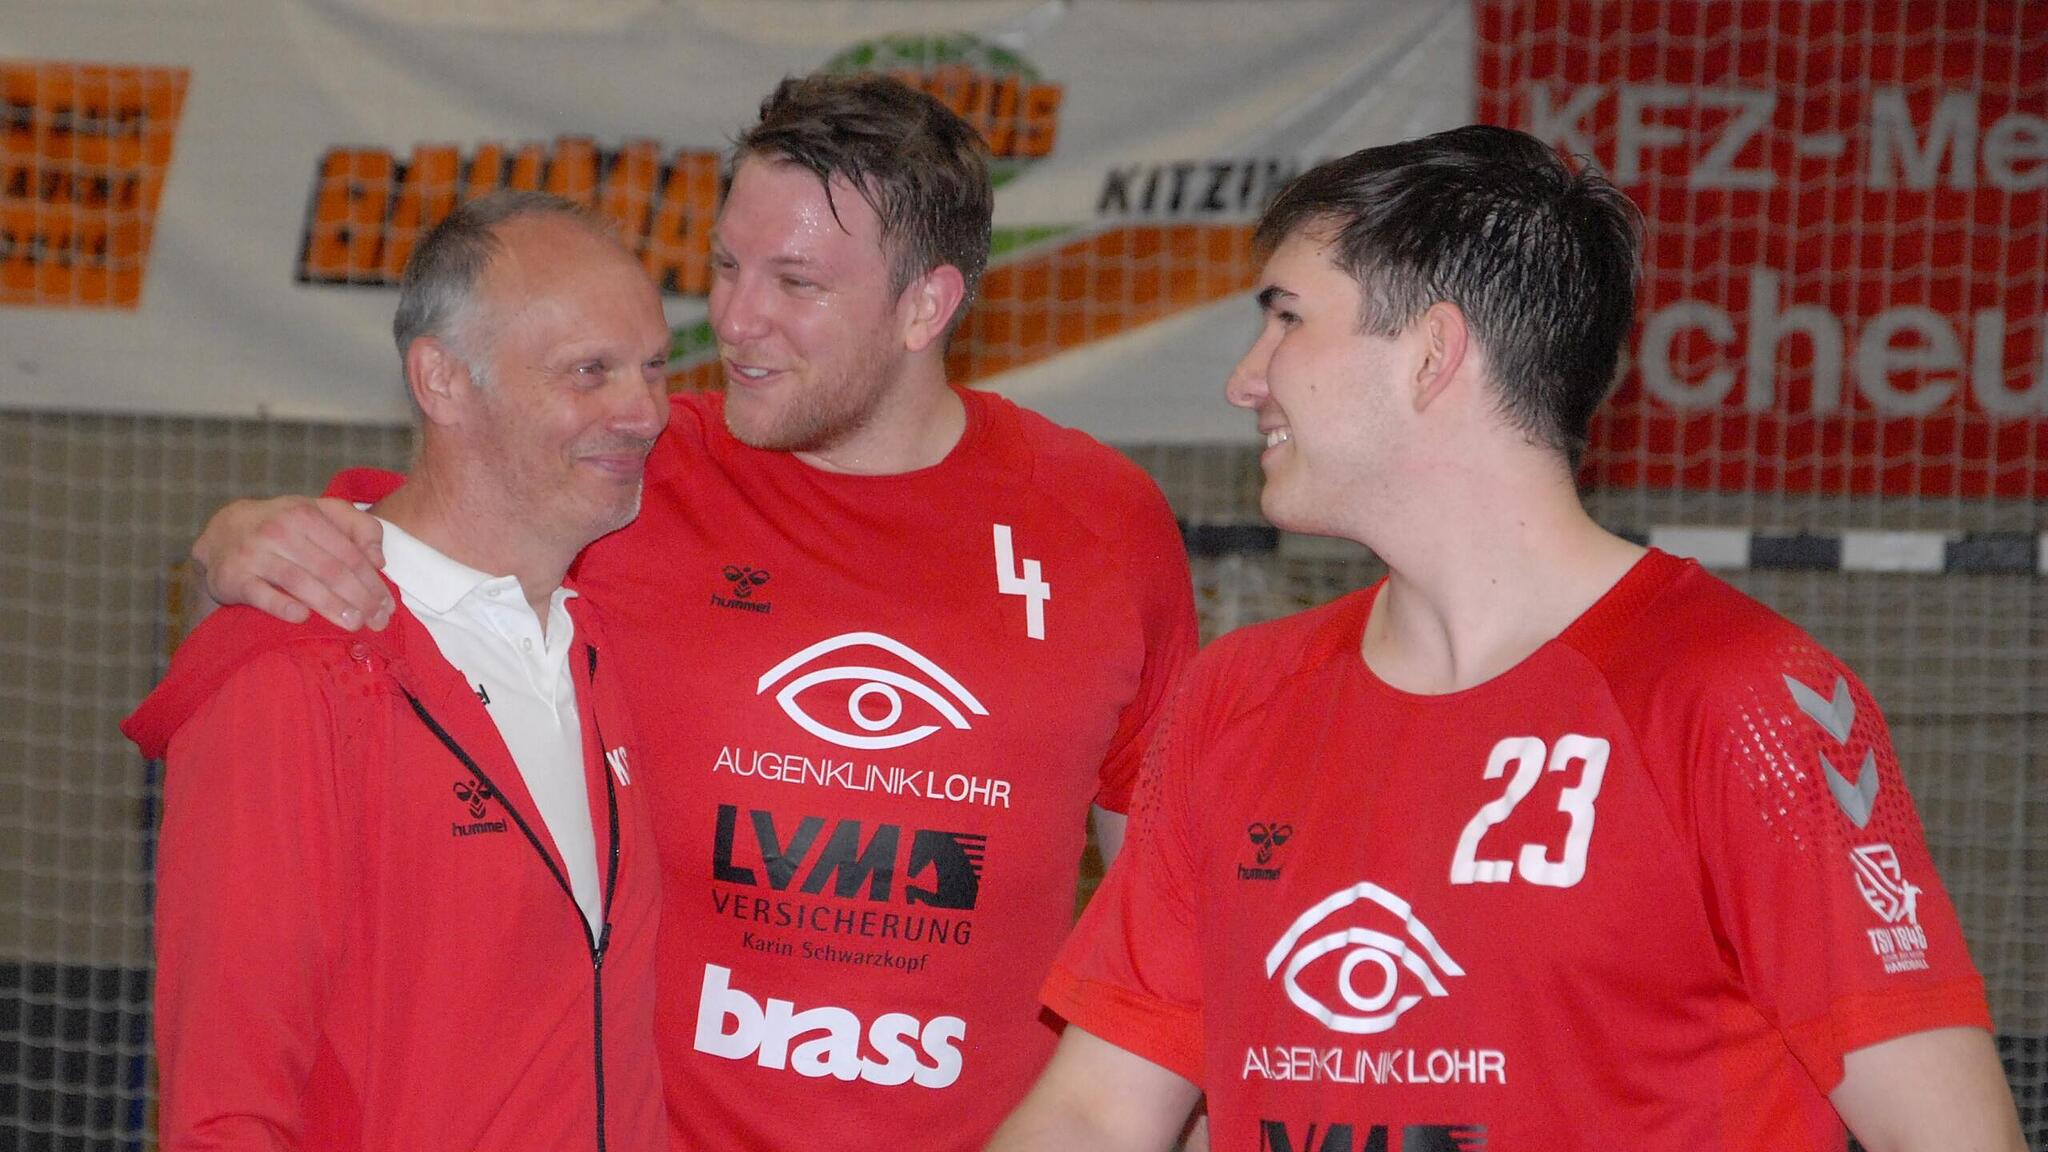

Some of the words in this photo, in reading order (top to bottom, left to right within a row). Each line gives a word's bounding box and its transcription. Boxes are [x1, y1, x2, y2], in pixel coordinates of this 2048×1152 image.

[1618, 267, 2048, 417] cheu
[710, 593, 772, 614] hummel
[993, 523, 1051, 641] 4
[713, 746, 921, 797] AUGENKLINIK
[926, 771, 1011, 808] LOHR
[452, 818, 508, 837] hummel
[1449, 734, 1611, 888] 23
[713, 804, 901, 903] LVM
[711, 888, 972, 945] VERSICHERUNG
[743, 931, 793, 956] Karin
[802, 941, 929, 973] Schwarzkopf
[694, 963, 967, 1090] brass
[1407, 1049, 1506, 1085] LOHR
